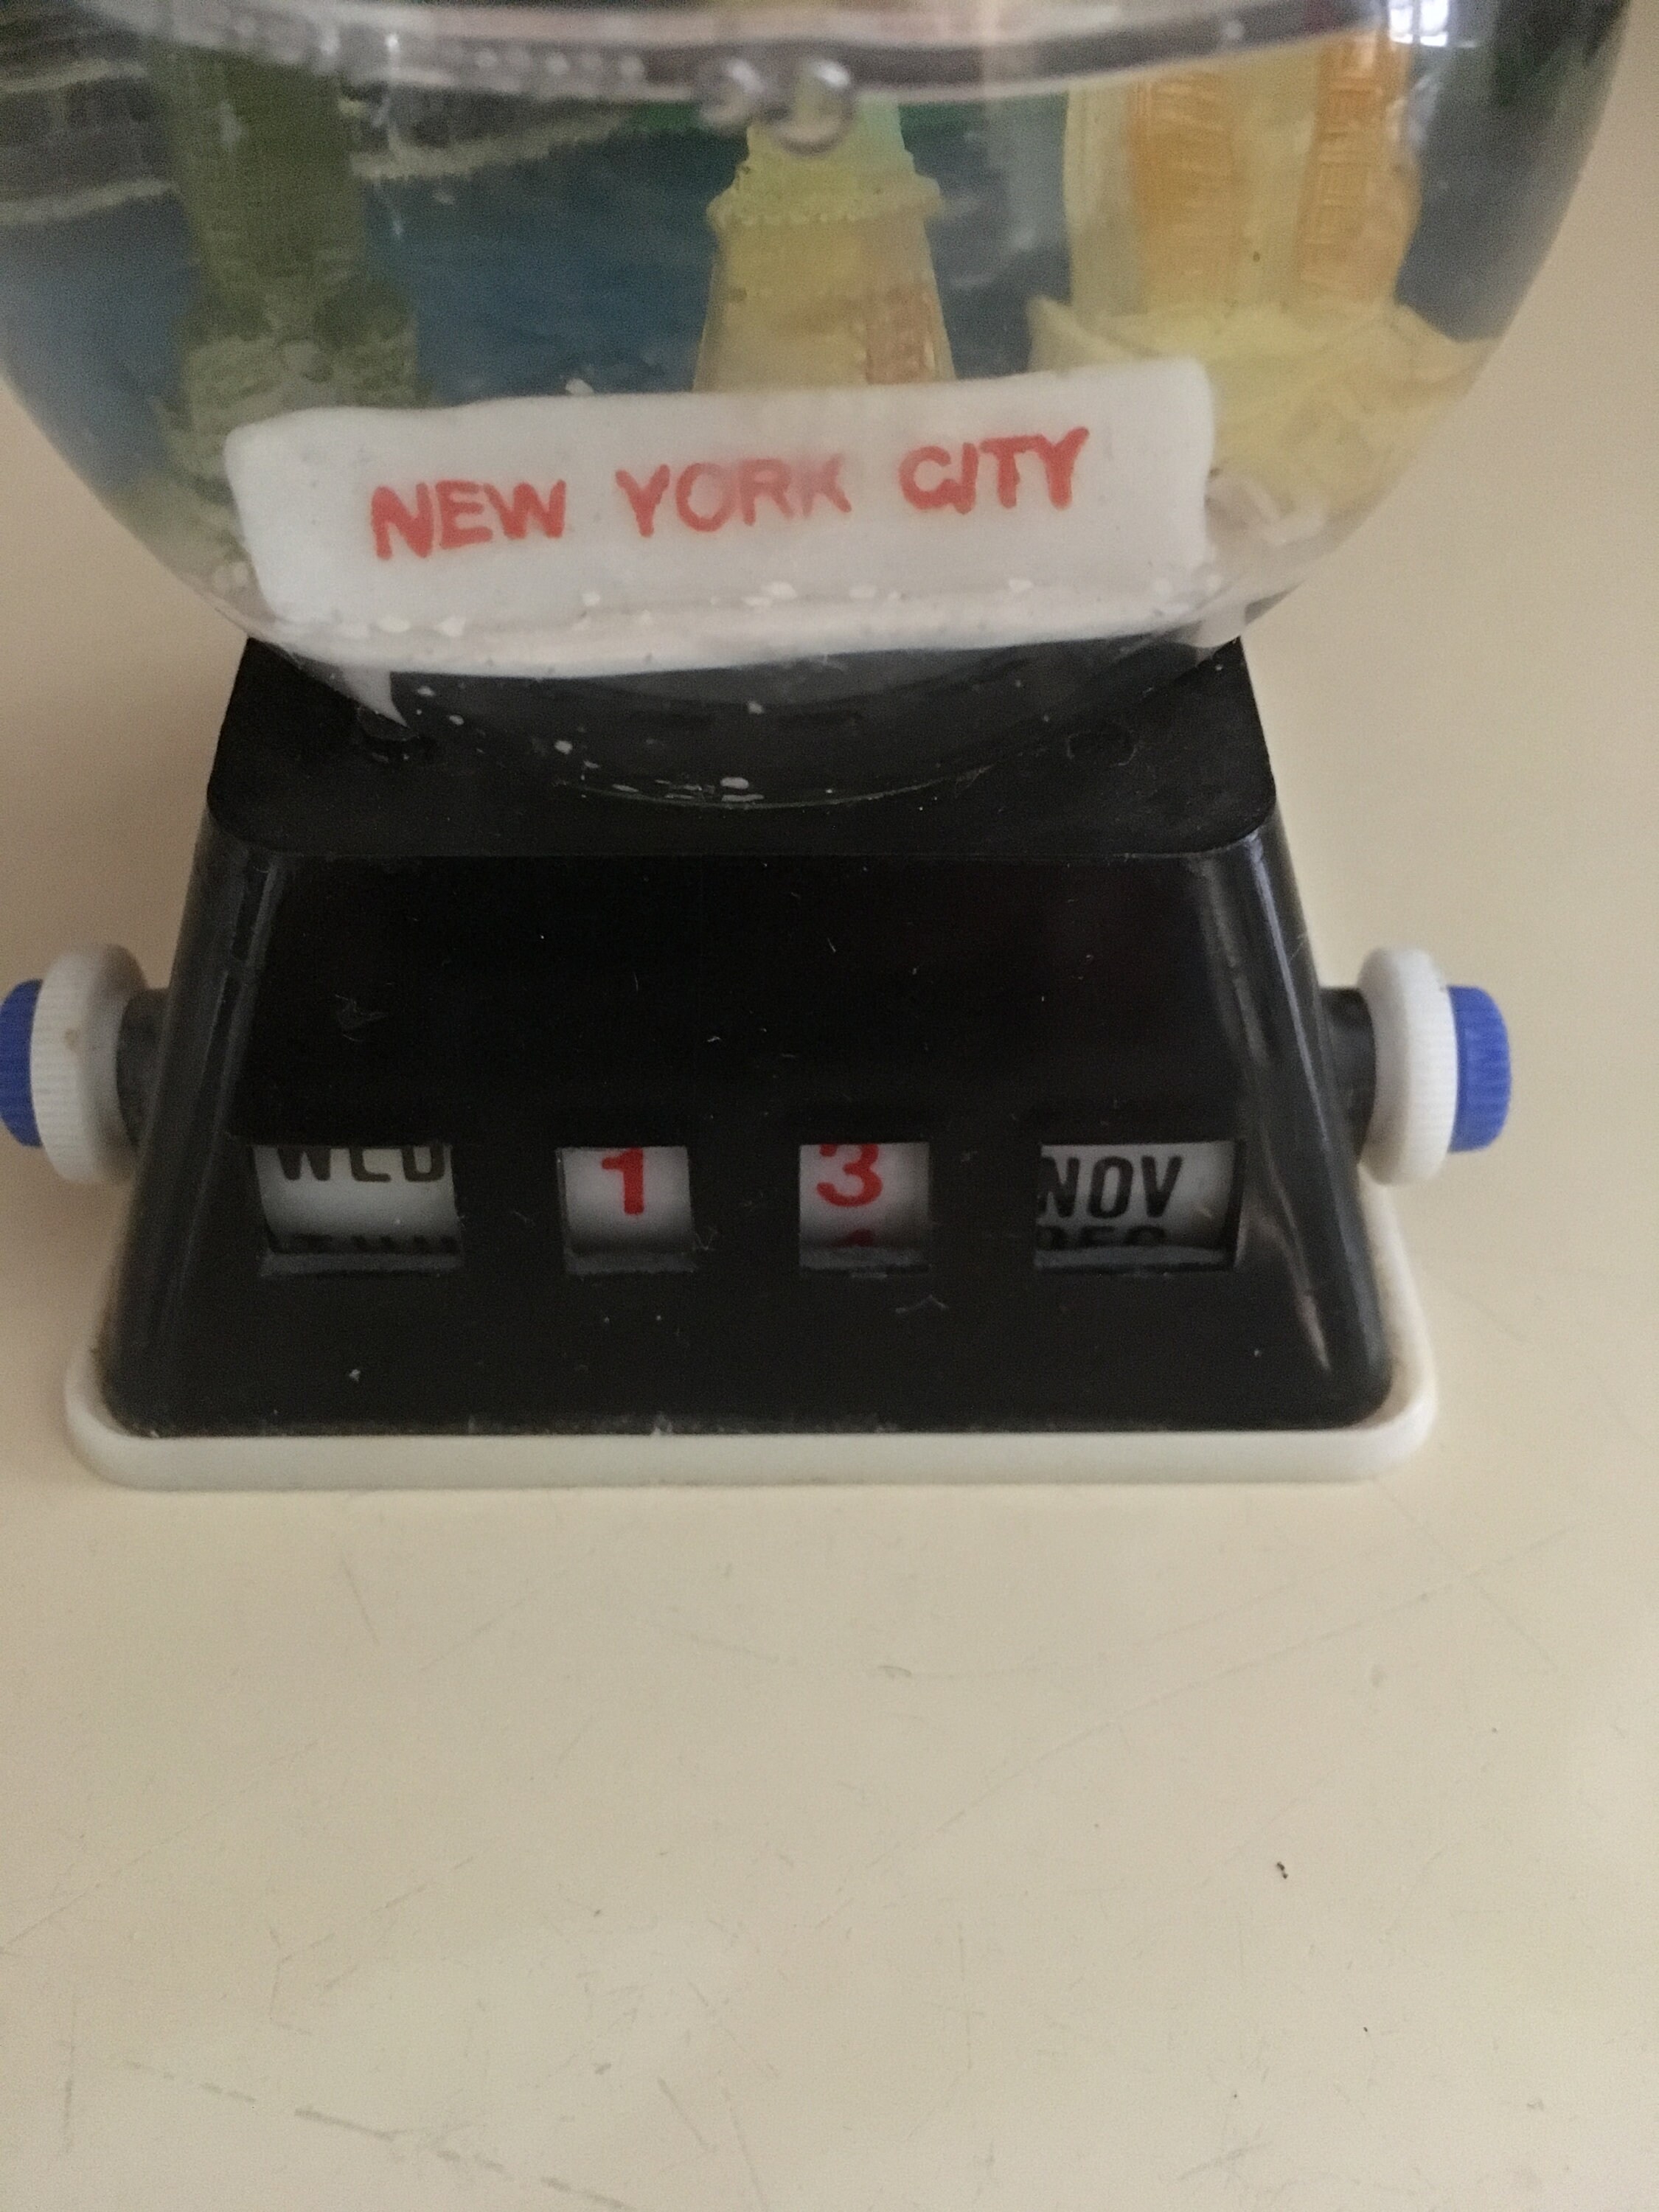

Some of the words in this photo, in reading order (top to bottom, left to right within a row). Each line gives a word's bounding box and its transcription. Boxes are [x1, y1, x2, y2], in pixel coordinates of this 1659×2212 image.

[369, 479, 567, 560] NEW
[615, 453, 852, 538] YORK
[898, 426, 1090, 515] CITY
[601, 1147, 645, 1216] 1
[816, 1144, 883, 1208] 3
[1035, 1155, 1183, 1219] NOV
